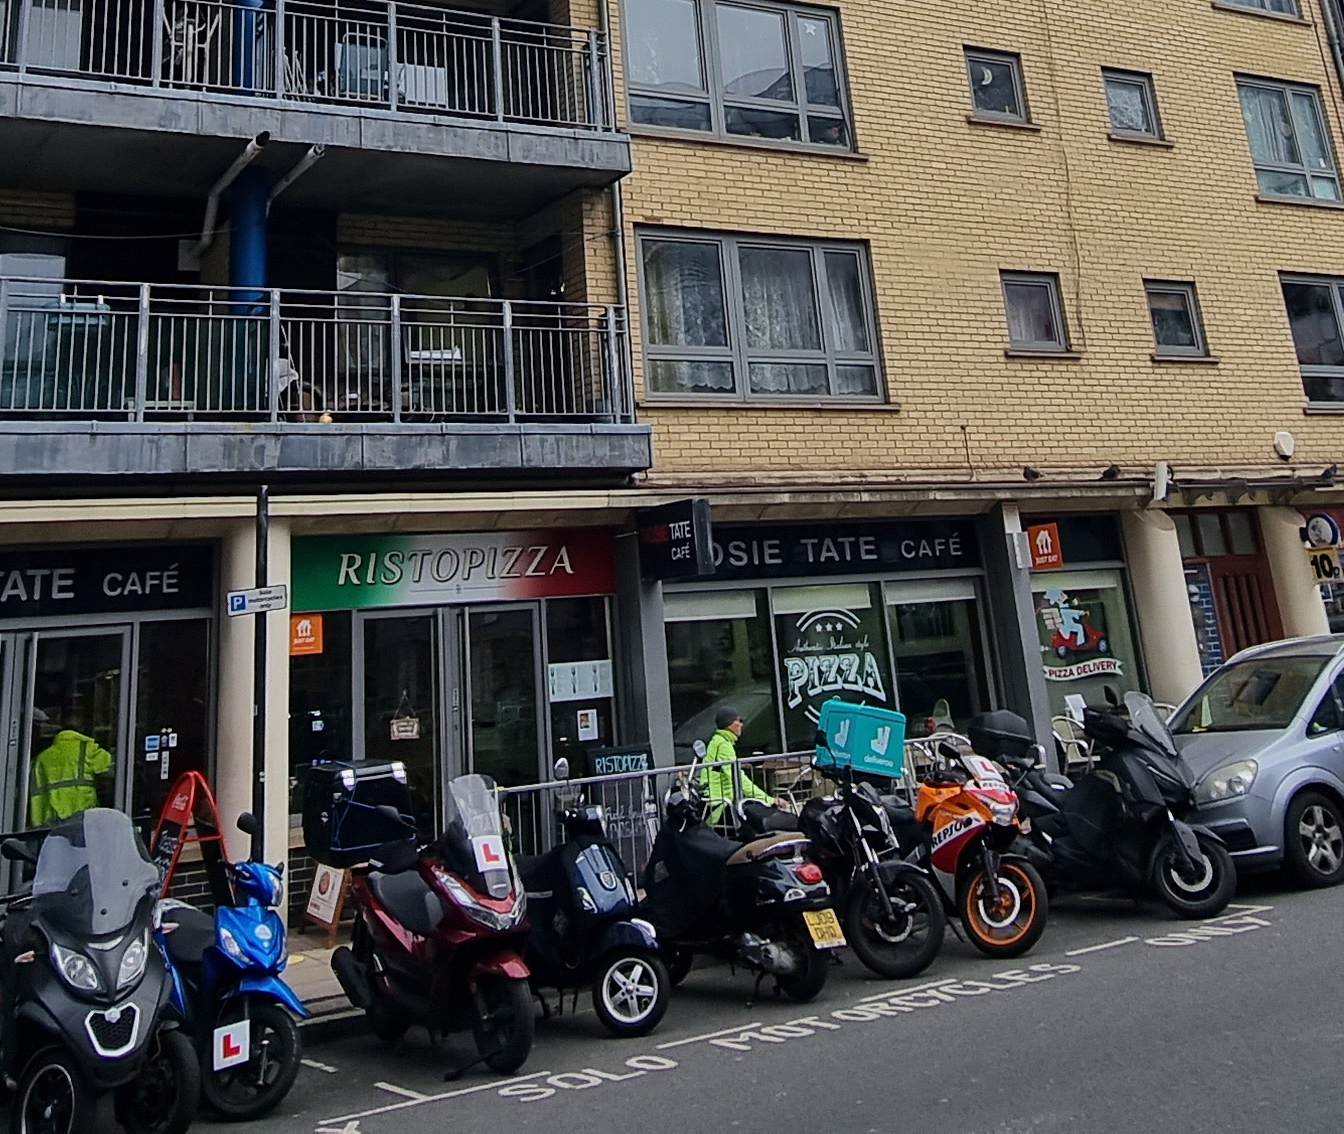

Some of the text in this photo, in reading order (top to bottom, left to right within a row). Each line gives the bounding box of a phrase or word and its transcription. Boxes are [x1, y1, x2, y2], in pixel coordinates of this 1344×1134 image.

[668, 520, 692, 541] TATE
[671, 542, 691, 561] CAFÉ
[799, 536, 878, 563] TATE
[900, 531, 963, 559] CAFÉ
[337, 544, 575, 586] RISTOPIZZA
[102, 562, 180, 597] CAFÉ
[783, 651, 887, 710] PIZZA
[1048, 660, 1119, 679] PIZZA DELIVERY
[979, 760, 996, 774] L
[481, 842, 501, 863] L
[222, 1033, 241, 1059] L
[497, 1054, 680, 1103] SOLO
